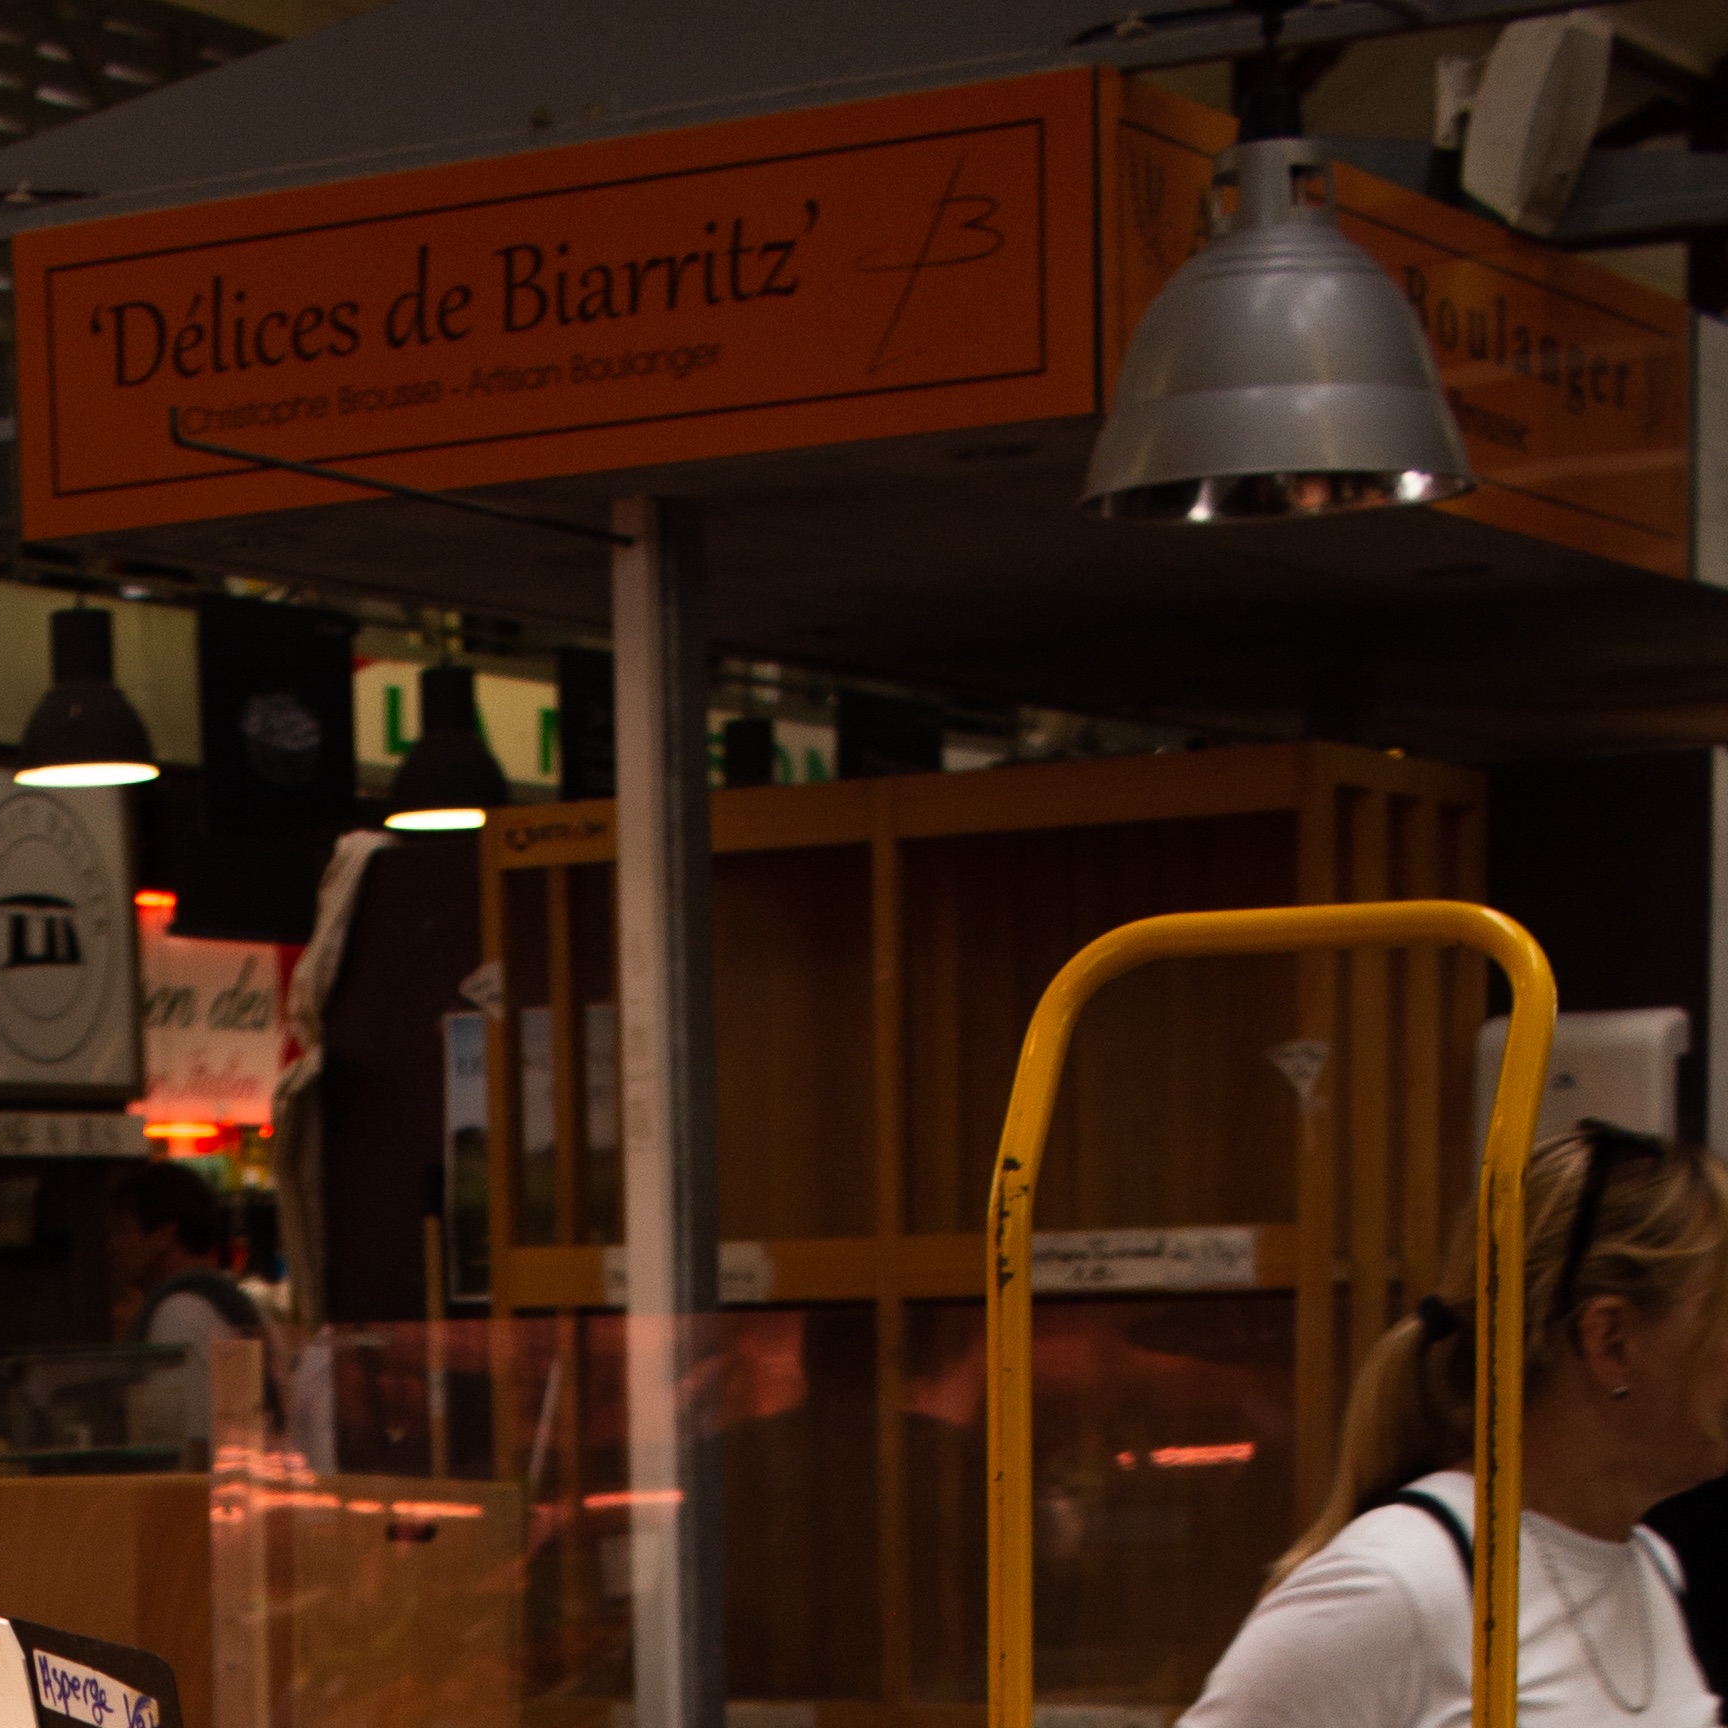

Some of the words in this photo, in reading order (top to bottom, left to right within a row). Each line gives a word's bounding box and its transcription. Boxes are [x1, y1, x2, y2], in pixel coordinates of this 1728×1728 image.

[385, 243, 472, 352] de
[572, 344, 722, 388] Boulanger
[38, 1654, 114, 1726] Asperge
